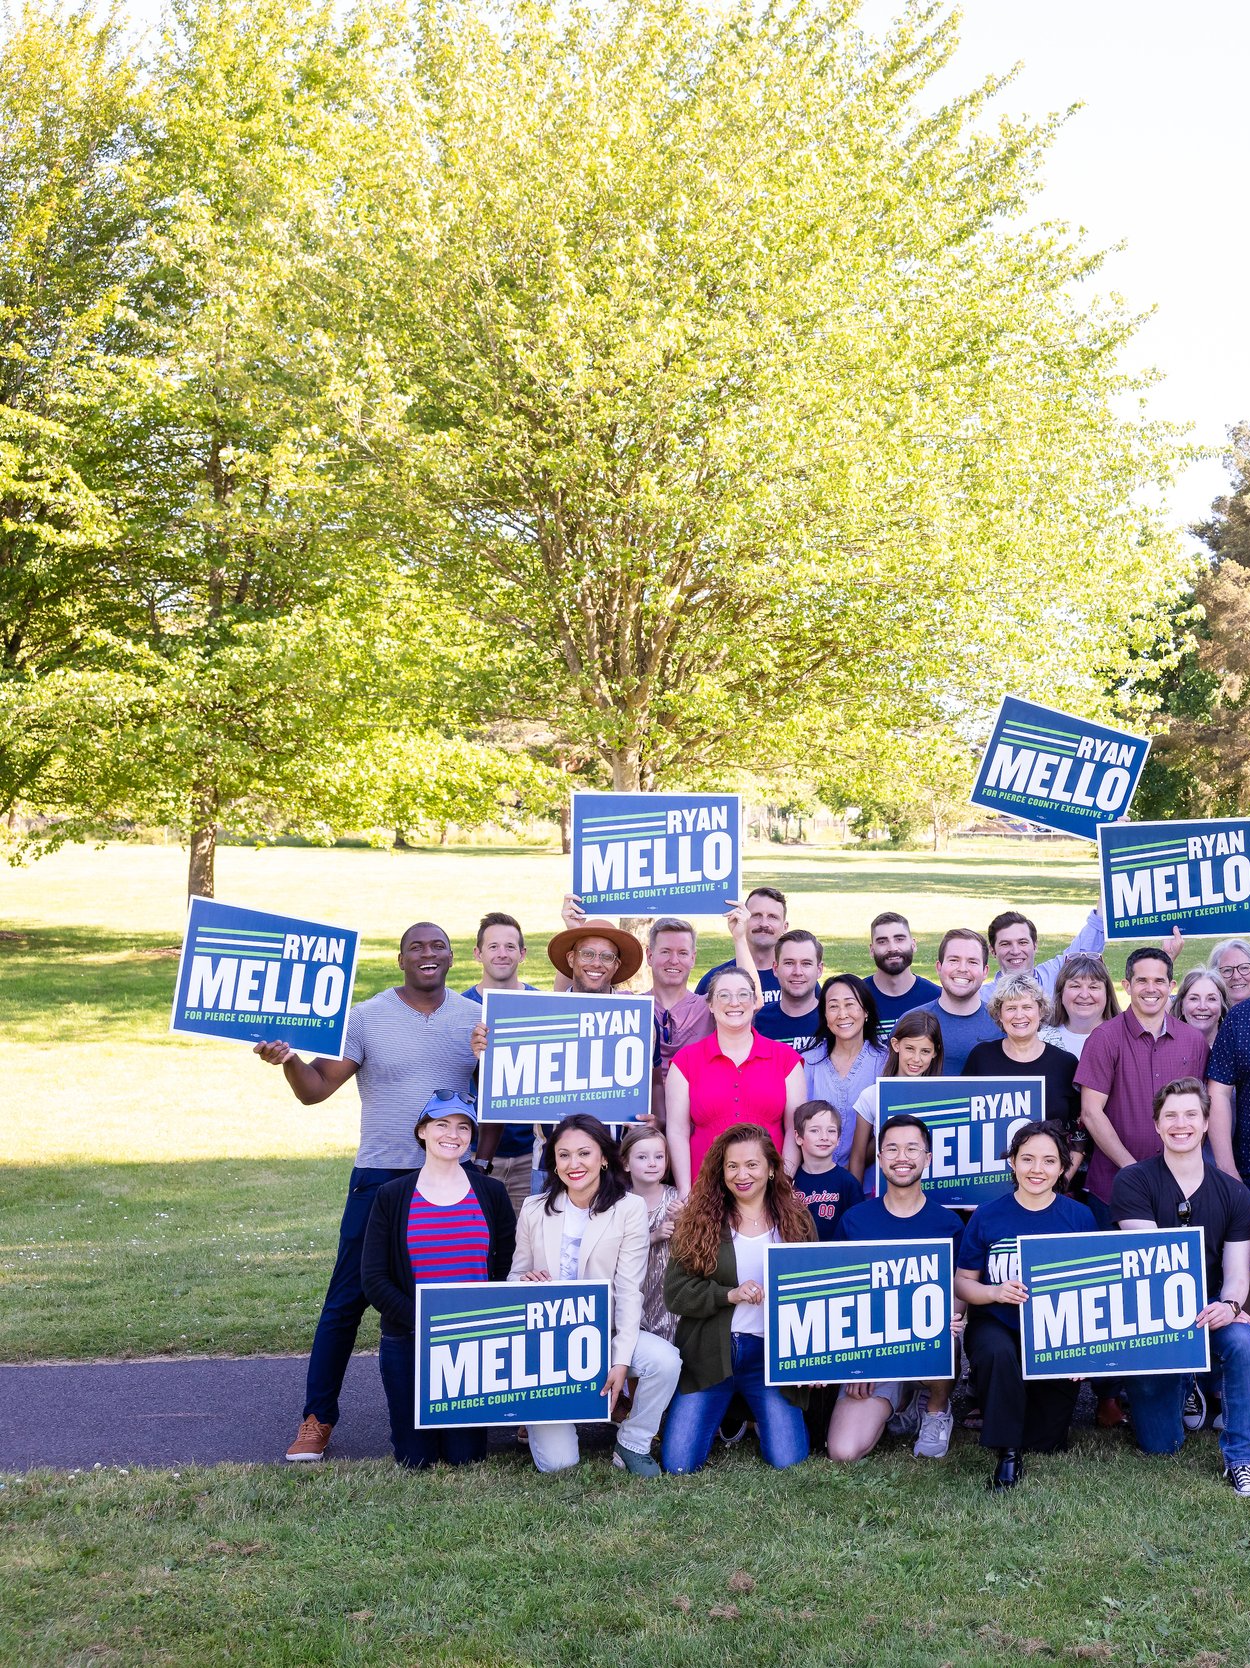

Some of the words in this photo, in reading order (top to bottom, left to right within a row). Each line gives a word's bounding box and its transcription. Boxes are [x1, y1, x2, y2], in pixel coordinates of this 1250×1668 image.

[1076, 736, 1136, 767] RYAN
[984, 743, 1130, 811] MELLO
[982, 788, 997, 797] FOR
[998, 791, 1026, 803] PIERCE
[1027, 797, 1059, 809] COUNTY
[1060, 804, 1102, 818] EXECUTIVE
[667, 805, 727, 834] RYAN
[1187, 830, 1245, 860] RYAN
[581, 831, 732, 893] MELLO
[582, 895, 598, 903] FOR
[600, 891, 630, 902] PIERCE
[633, 888, 667, 898] COUNTY
[670, 883, 715, 895] EXECUTIVE
[1115, 919, 1129, 928] FOR
[1132, 915, 1159, 926] PIERCE
[1161, 910, 1192, 921] COUNTY
[1195, 904, 1237, 916] EXECUTIVE
[1244, 902, 1249, 910] D
[283, 934, 346, 963] RYAN
[186, 955, 345, 1017] MELLO
[764, 990, 782, 1003] RY
[184, 1011, 202, 1020] FOR
[204, 1012, 236, 1022] PIERCE
[238, 1014, 274, 1024] COUNTY
[276, 1016, 322, 1027] EXECUTIVE
[329, 1019, 334, 1027] D
[579, 1009, 640, 1037] RYAN
[491, 1036, 644, 1097] MELLO
[491, 1099, 507, 1108] FOR
[510, 1096, 540, 1107] PIERCE
[543, 1093, 577, 1104] COUNTY
[580, 1089, 625, 1101] EXECUTIVE
[633, 1088, 639, 1096] D
[971, 1090, 1030, 1121] RYAN
[920, 1118, 1032, 1179] ELL
[937, 1177, 971, 1189] COUNTY
[973, 1173, 1012, 1185] EXECUTI
[818, 1203, 835, 1218] 00
[871, 1253, 938, 1289] RYAN
[1122, 1241, 1189, 1279] RYAN
[527, 1295, 595, 1330] RYAN
[778, 1283, 944, 1358] MELLO
[1032, 1272, 1197, 1350] MELLO
[779, 1360, 797, 1370] FOR
[800, 1354, 832, 1367] PIERCE
[835, 1349, 872, 1362] COUNTY
[876, 1341, 925, 1357] EXECUTIVE
[934, 1340, 940, 1349] D
[1035, 1352, 1052, 1363] FOR
[1055, 1346, 1086, 1360] PIERCE
[1089, 1340, 1126, 1354] COUNTY
[1129, 1332, 1179, 1348] EXECUTIVE
[1187, 1330, 1193, 1339] D
[429, 1325, 601, 1400] MELLO
[430, 1402, 448, 1413] FOR
[451, 1397, 484, 1410] PIERCE
[488, 1391, 527, 1405] COUNTY
[530, 1384, 581, 1399] EXECUTIVE
[590, 1382, 596, 1391] D
